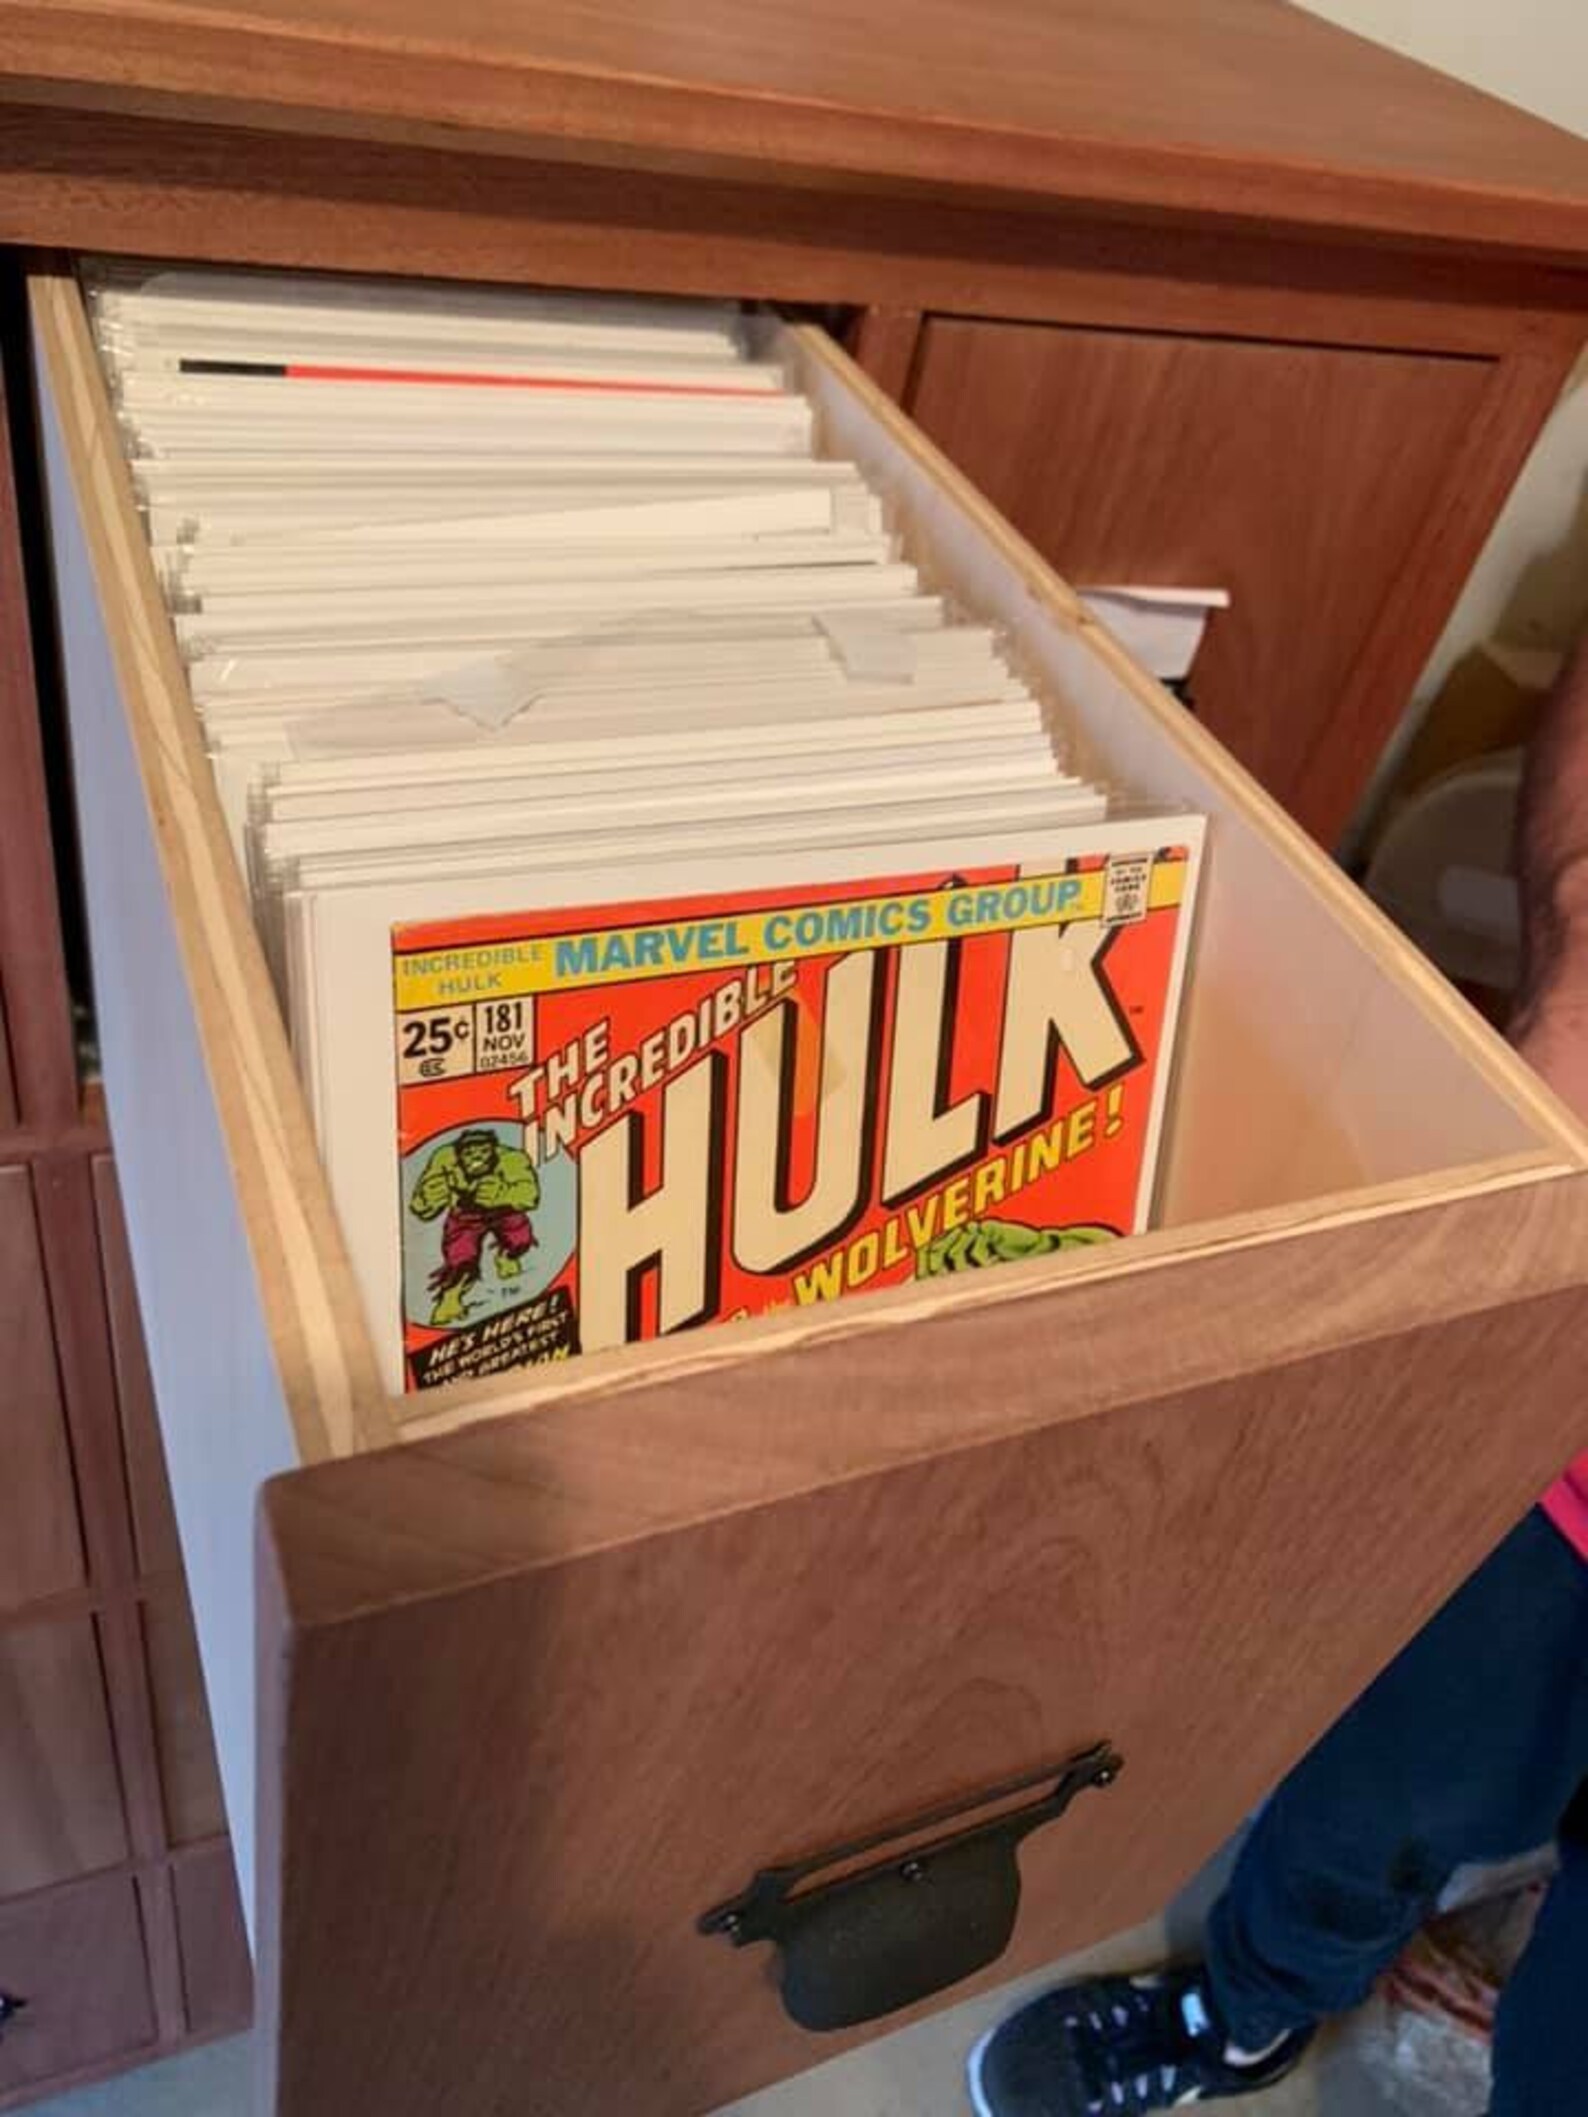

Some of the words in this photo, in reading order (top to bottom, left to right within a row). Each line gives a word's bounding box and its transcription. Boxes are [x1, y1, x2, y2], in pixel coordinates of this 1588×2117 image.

[402, 943, 543, 976] INCREDIBLE
[554, 920, 750, 979] MARVEL
[763, 897, 933, 951] COMICS
[946, 878, 1083, 928] GROUP
[437, 972, 503, 997] HULK
[484, 1001, 522, 1034] 181
[483, 1033, 526, 1052] NOV
[507, 1016, 611, 1119] THE
[522, 959, 799, 1169] INCREDIBLE
[577, 912, 1146, 1354] HULK
[792, 1083, 1126, 1306] WOLVERINE!
